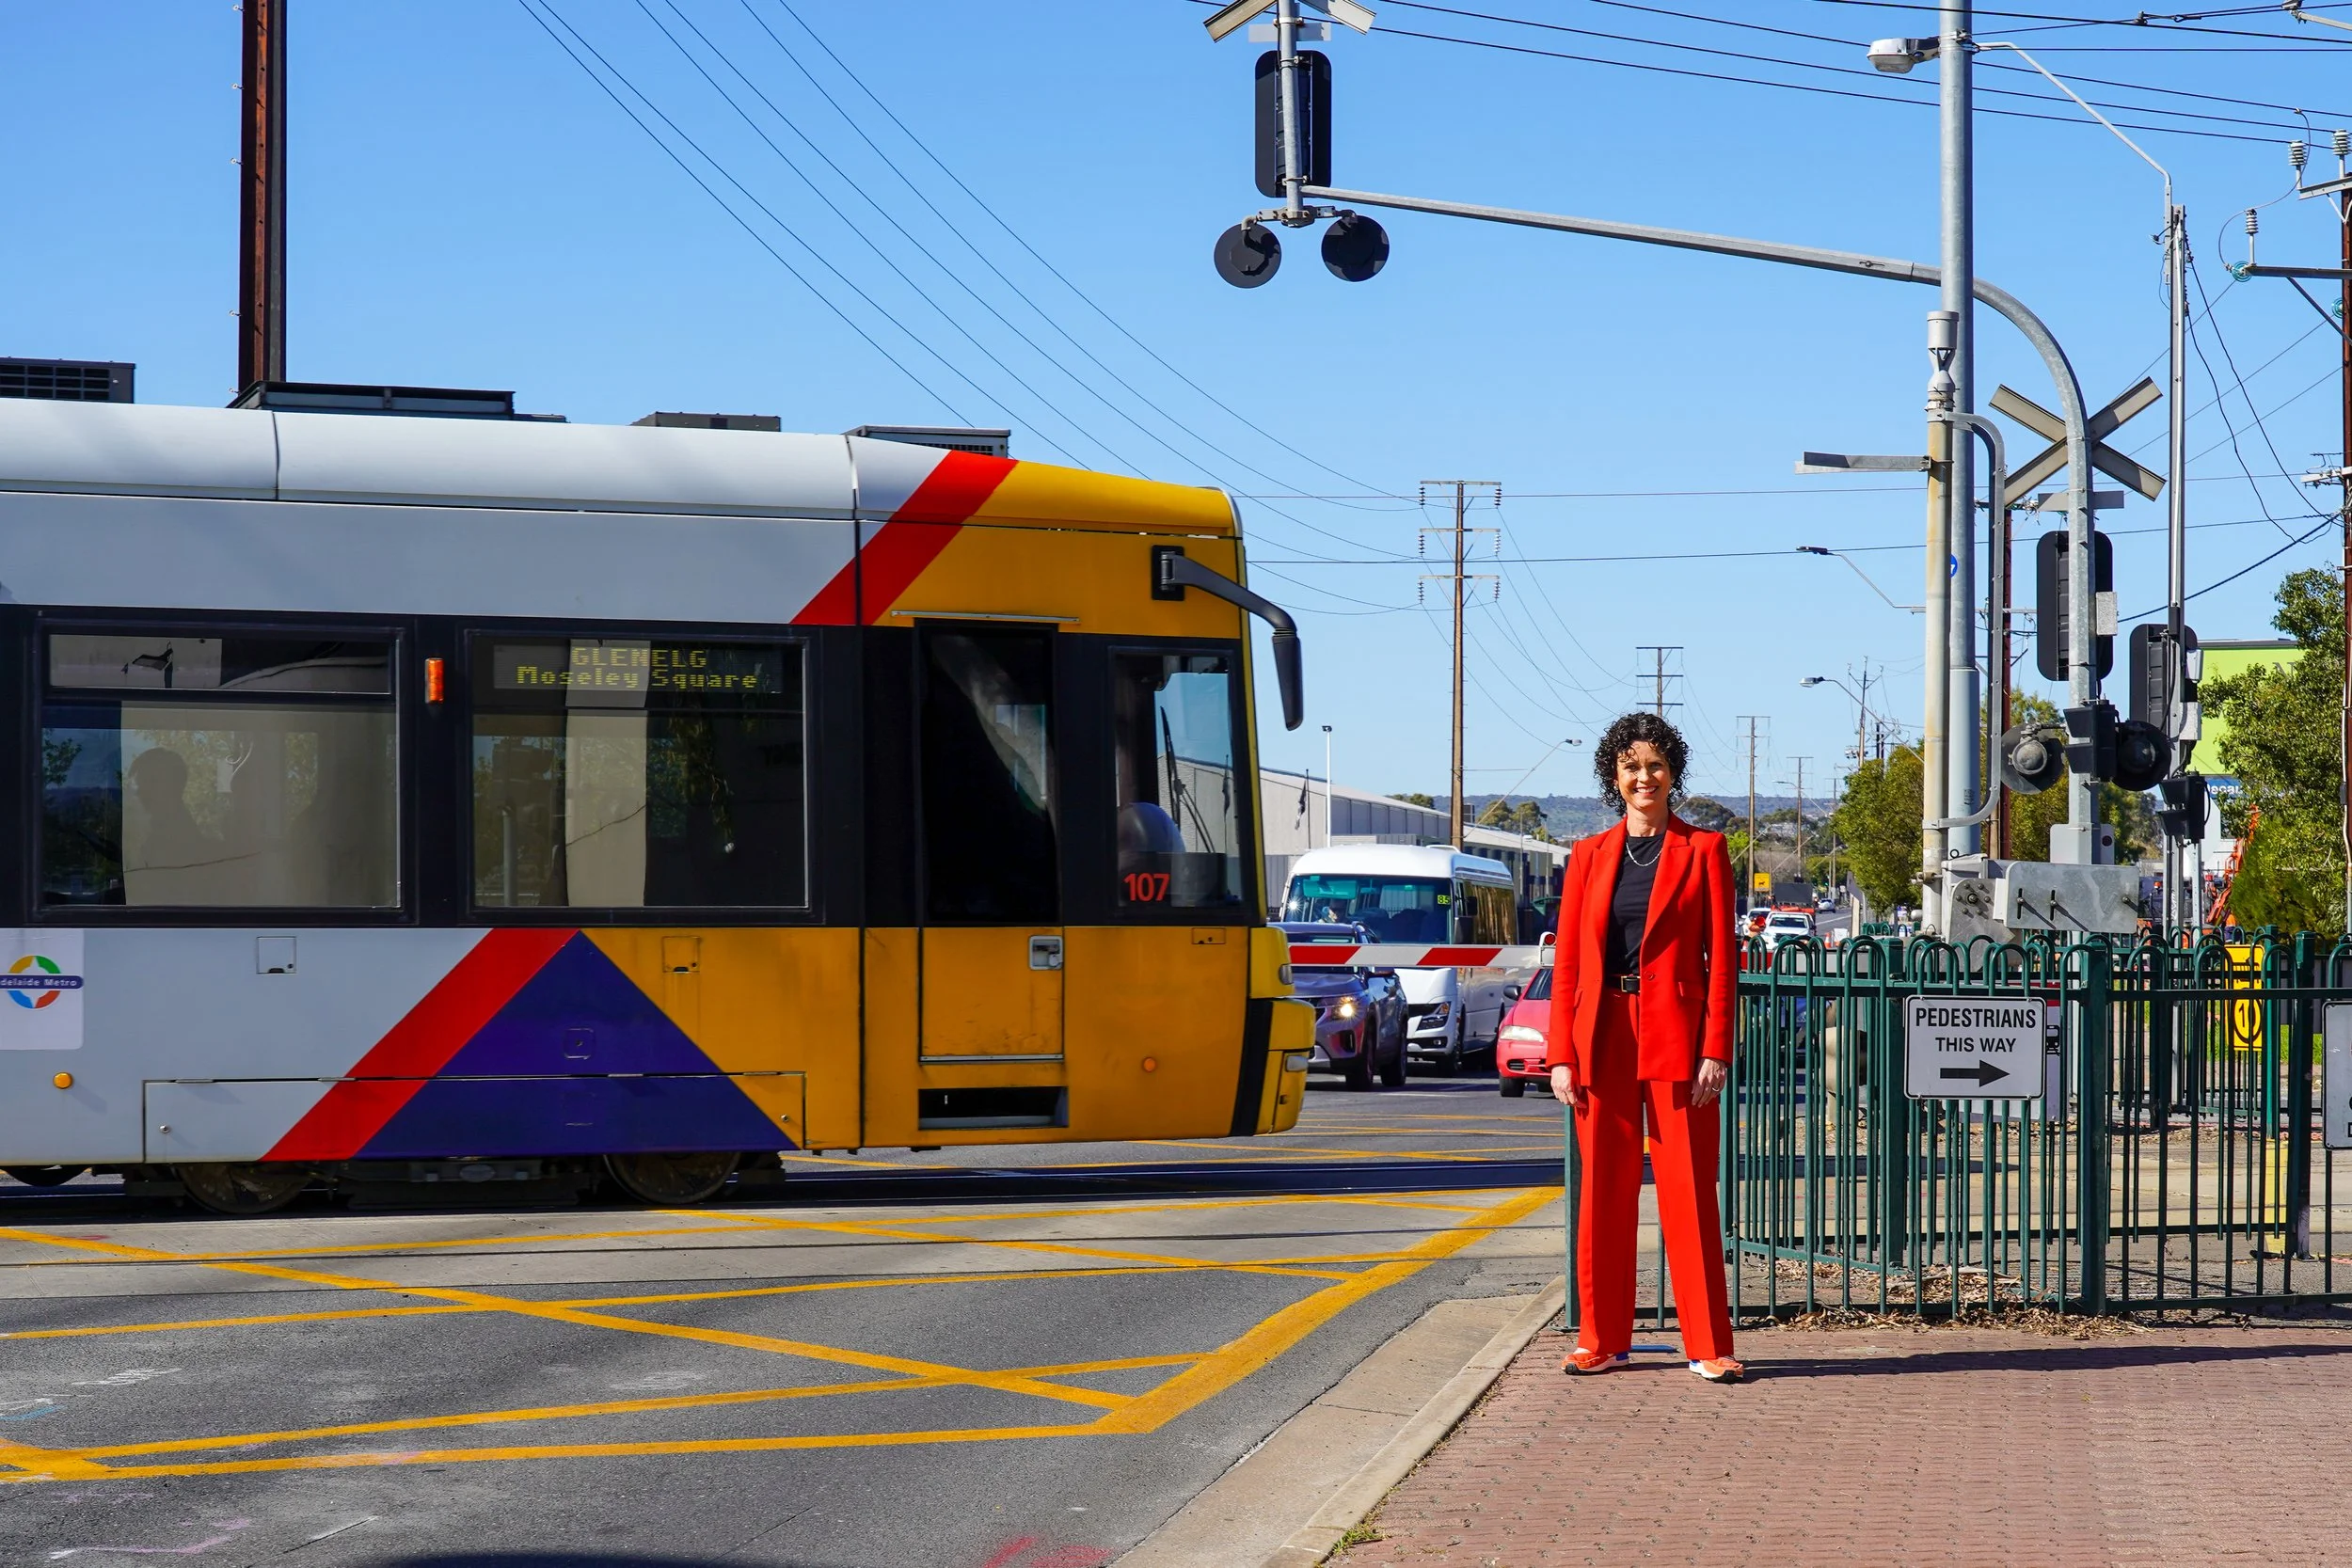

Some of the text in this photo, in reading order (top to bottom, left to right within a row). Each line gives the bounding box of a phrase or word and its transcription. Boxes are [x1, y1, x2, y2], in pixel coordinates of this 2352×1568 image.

[571, 647, 707, 669] GLENELG
[516, 666, 757, 689] Moseley Square
[1123, 873, 1169, 901] 107
[0, 978, 77, 987] delaide Metro
[1915, 1007, 2036, 1028] PEDESTRIANS
[1935, 1037, 2017, 1053] THIS WAY
